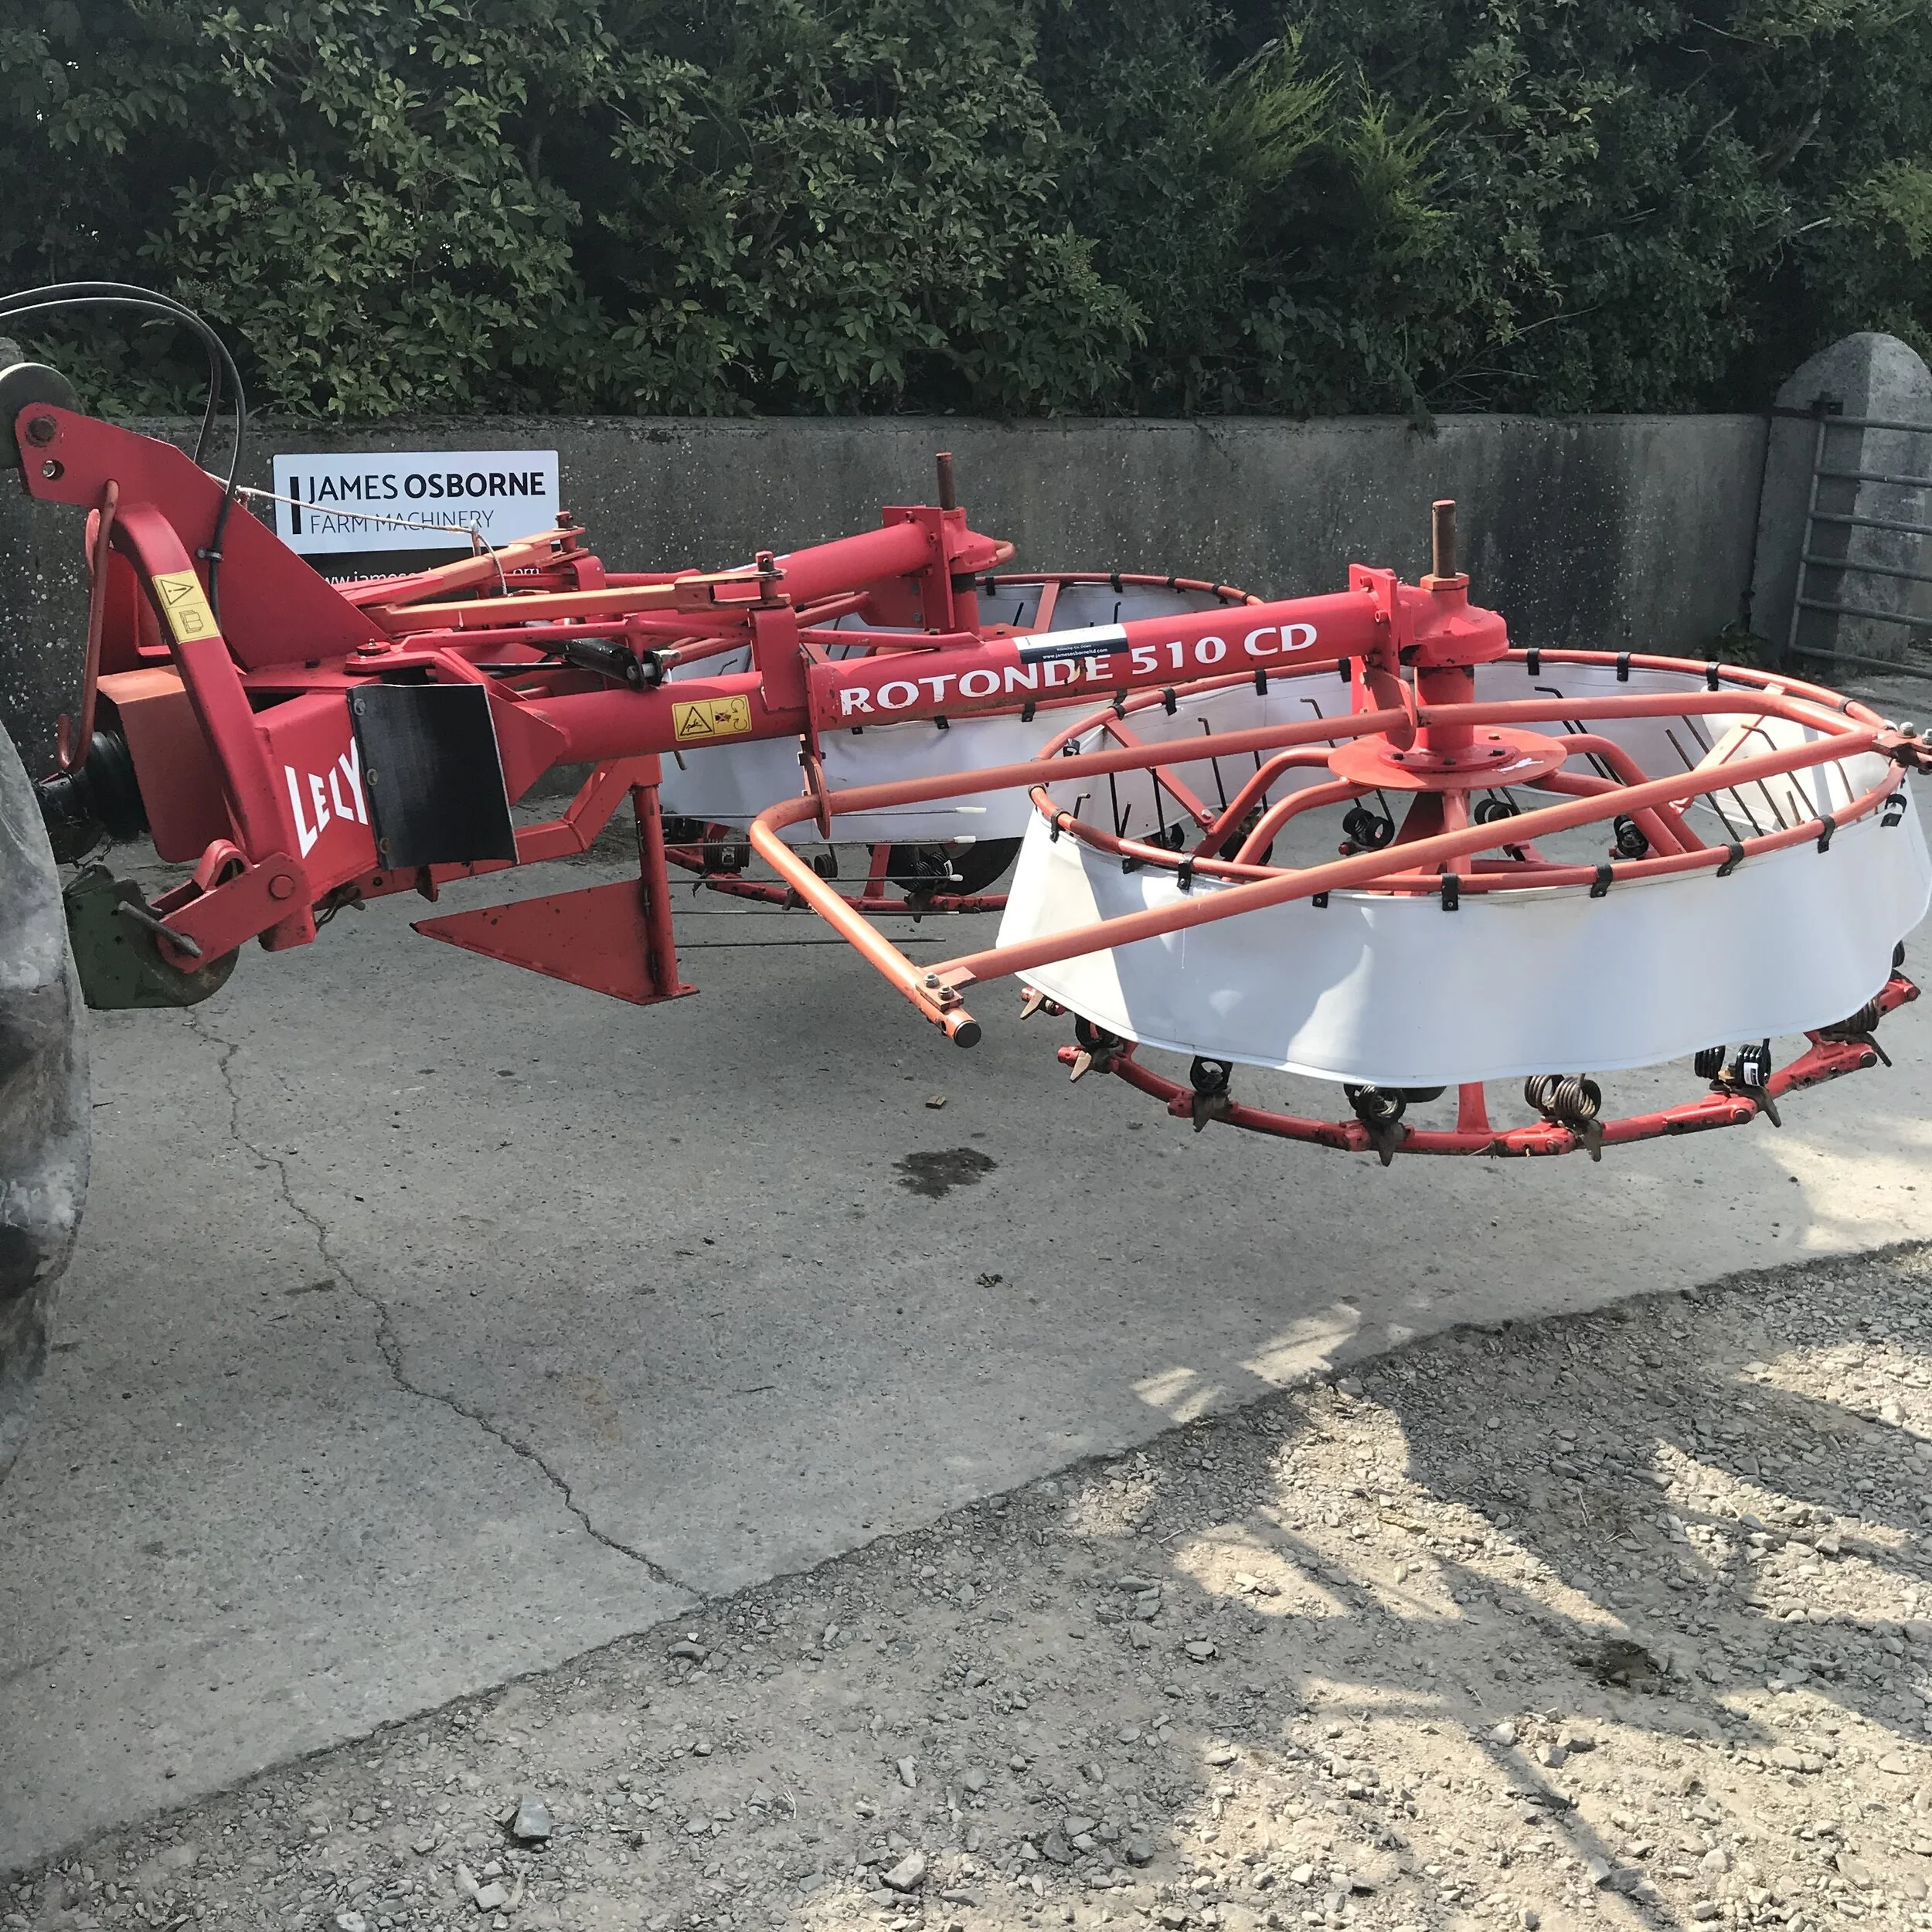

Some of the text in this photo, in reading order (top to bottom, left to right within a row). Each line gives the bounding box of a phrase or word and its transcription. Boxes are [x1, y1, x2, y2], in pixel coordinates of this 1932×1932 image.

[308, 472, 546, 504] JAMES OSBORNE
[311, 510, 495, 534] FARM MACHINERY
[840, 623, 1318, 715] ROTONDE 510 CD
[284, 736, 369, 859] LELY
